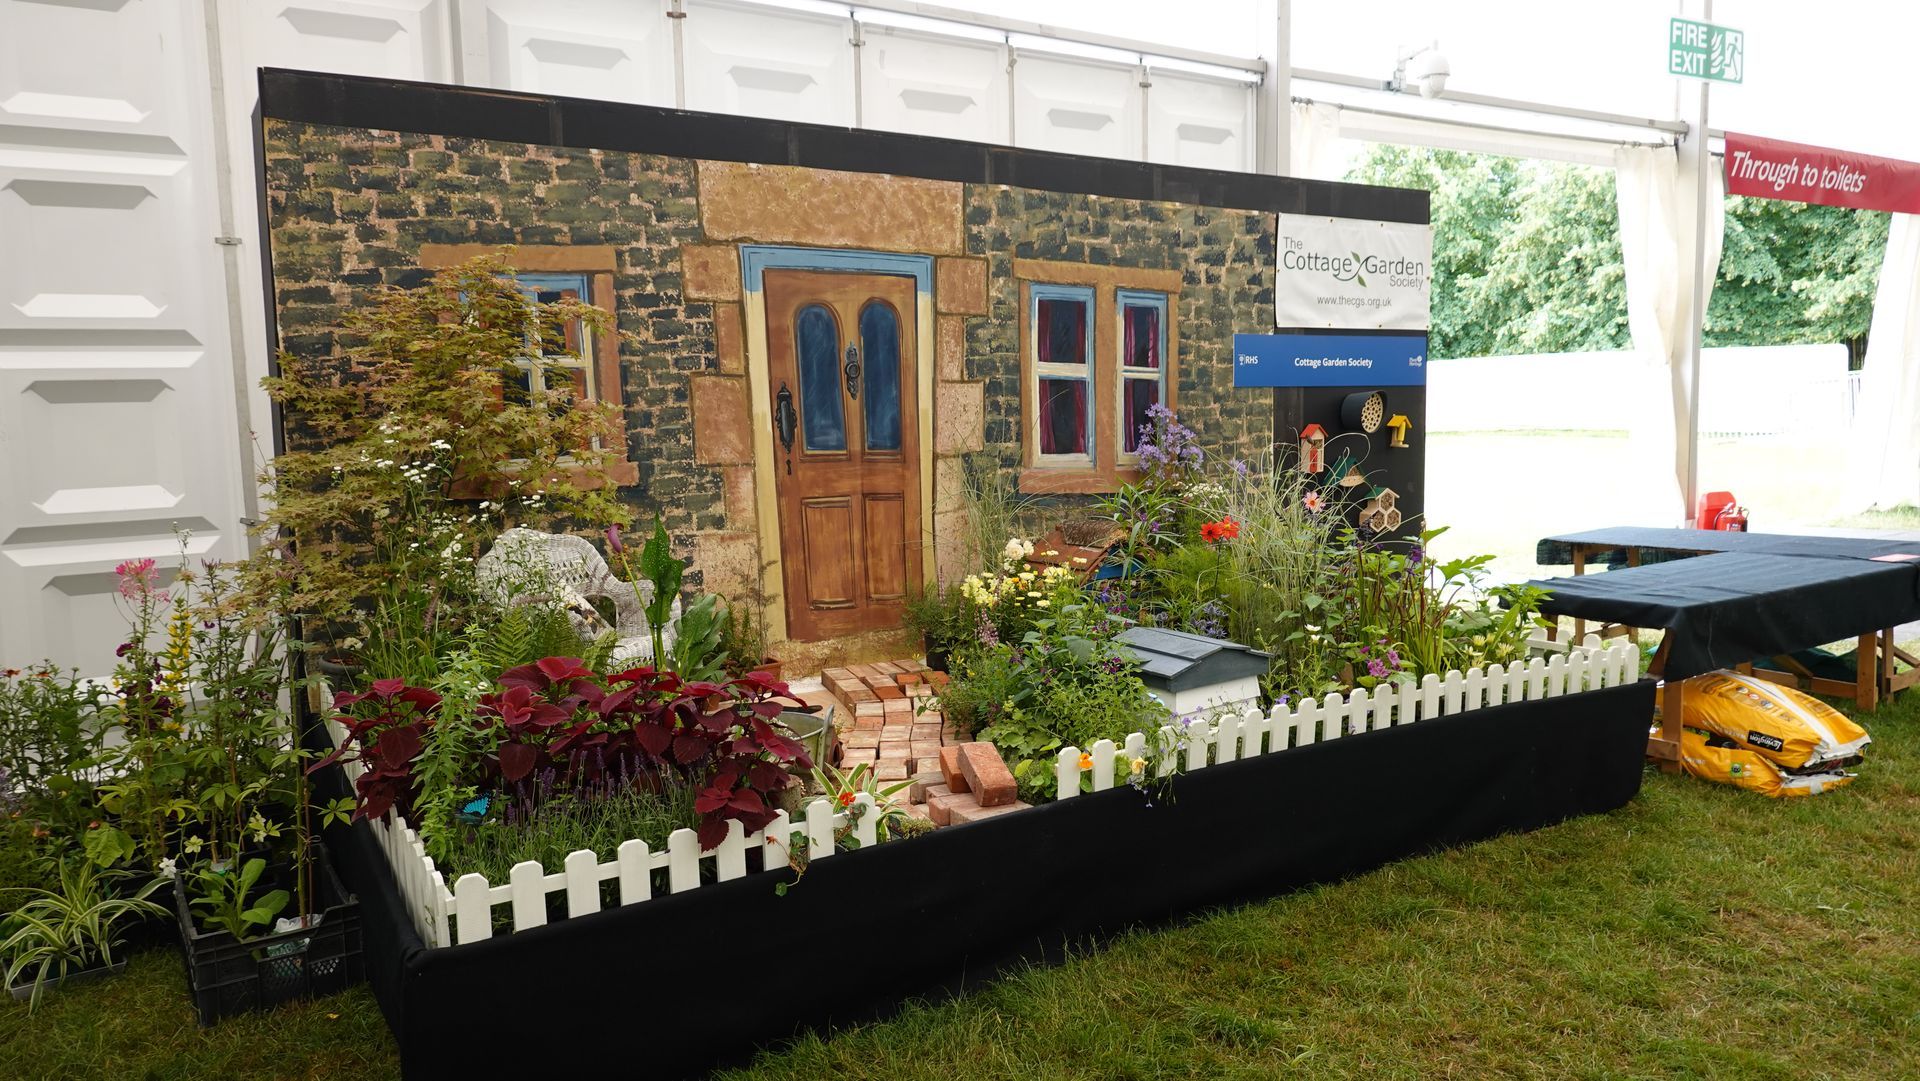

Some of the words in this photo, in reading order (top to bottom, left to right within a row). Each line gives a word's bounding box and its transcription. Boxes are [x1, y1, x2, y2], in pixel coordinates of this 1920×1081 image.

[1672, 22, 1707, 48] FIRE
[1672, 50, 1706, 75] EXIT
[1731, 151, 1798, 191] Through
[1801, 163, 1818, 186] to
[1821, 165, 1866, 193] toilets
[1283, 236, 1303, 250] The
[1283, 250, 1353, 277] Cottage
[1364, 255, 1424, 276] Garden
[1389, 275, 1423, 291] Society
[1317, 296, 1392, 309] www.thecgs.org.uk
[1245, 355, 1258, 365] RHS
[1294, 357, 1321, 369] Cottage
[1322, 357, 1347, 367] Garden
[1348, 357, 1373, 369] Society
